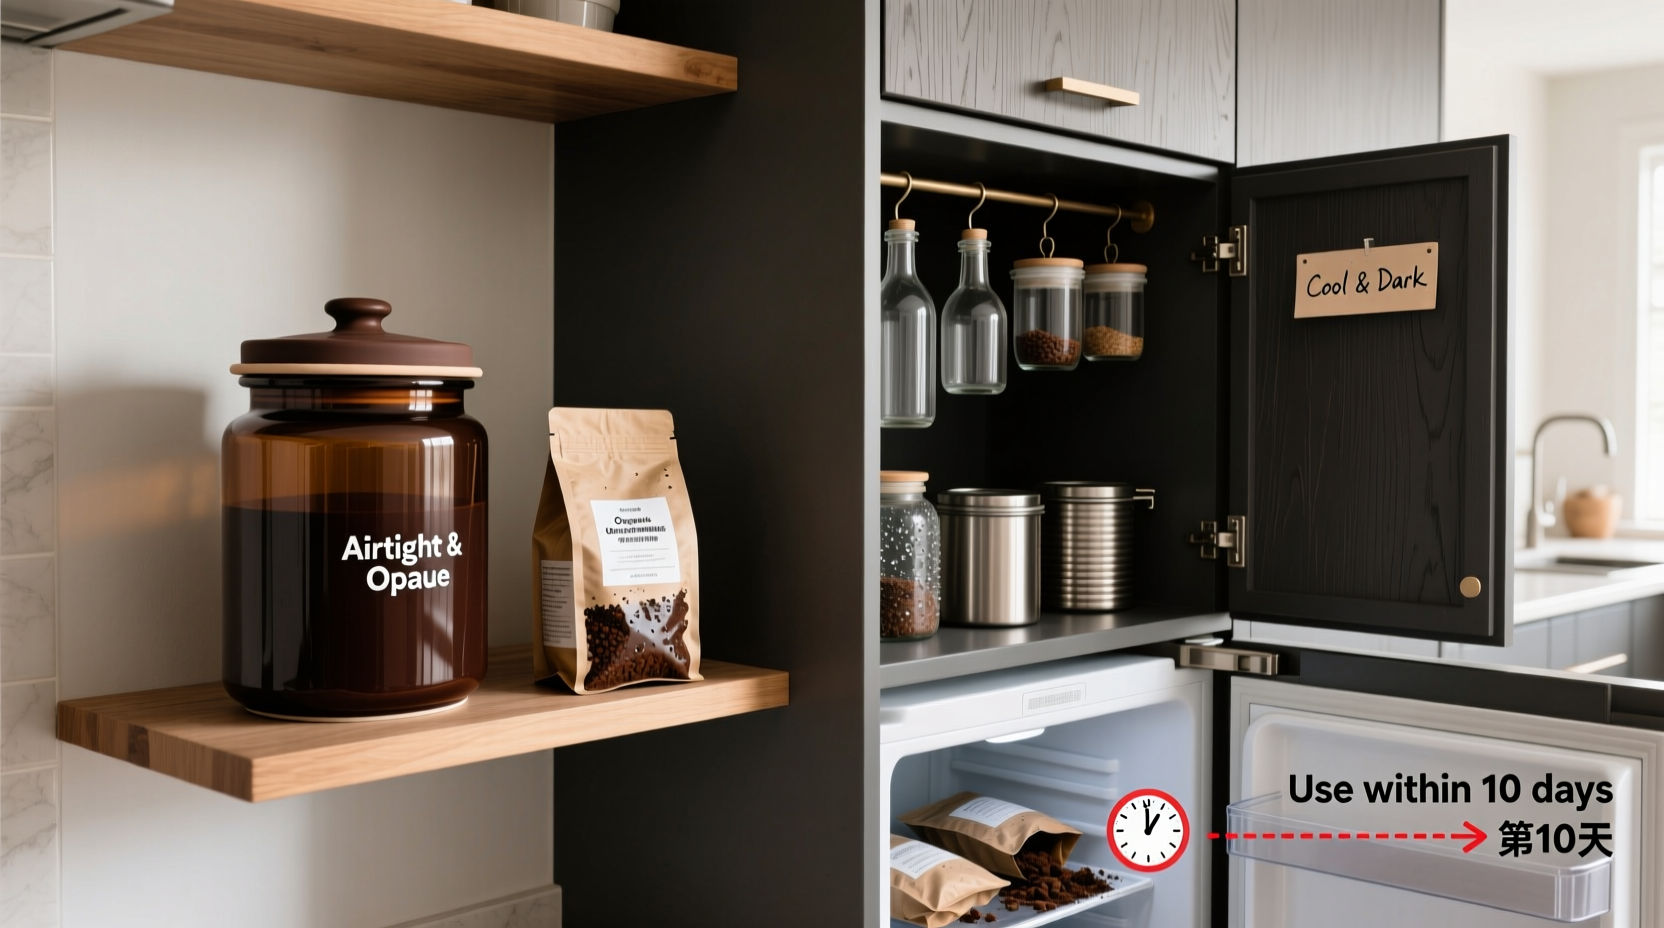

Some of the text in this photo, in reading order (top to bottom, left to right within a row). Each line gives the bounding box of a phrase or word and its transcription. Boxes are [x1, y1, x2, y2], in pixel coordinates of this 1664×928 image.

[1307, 265, 1427, 297] Cool & Dark
[341, 531, 463, 566] Airtight &
[366, 565, 450, 597] Opaue
